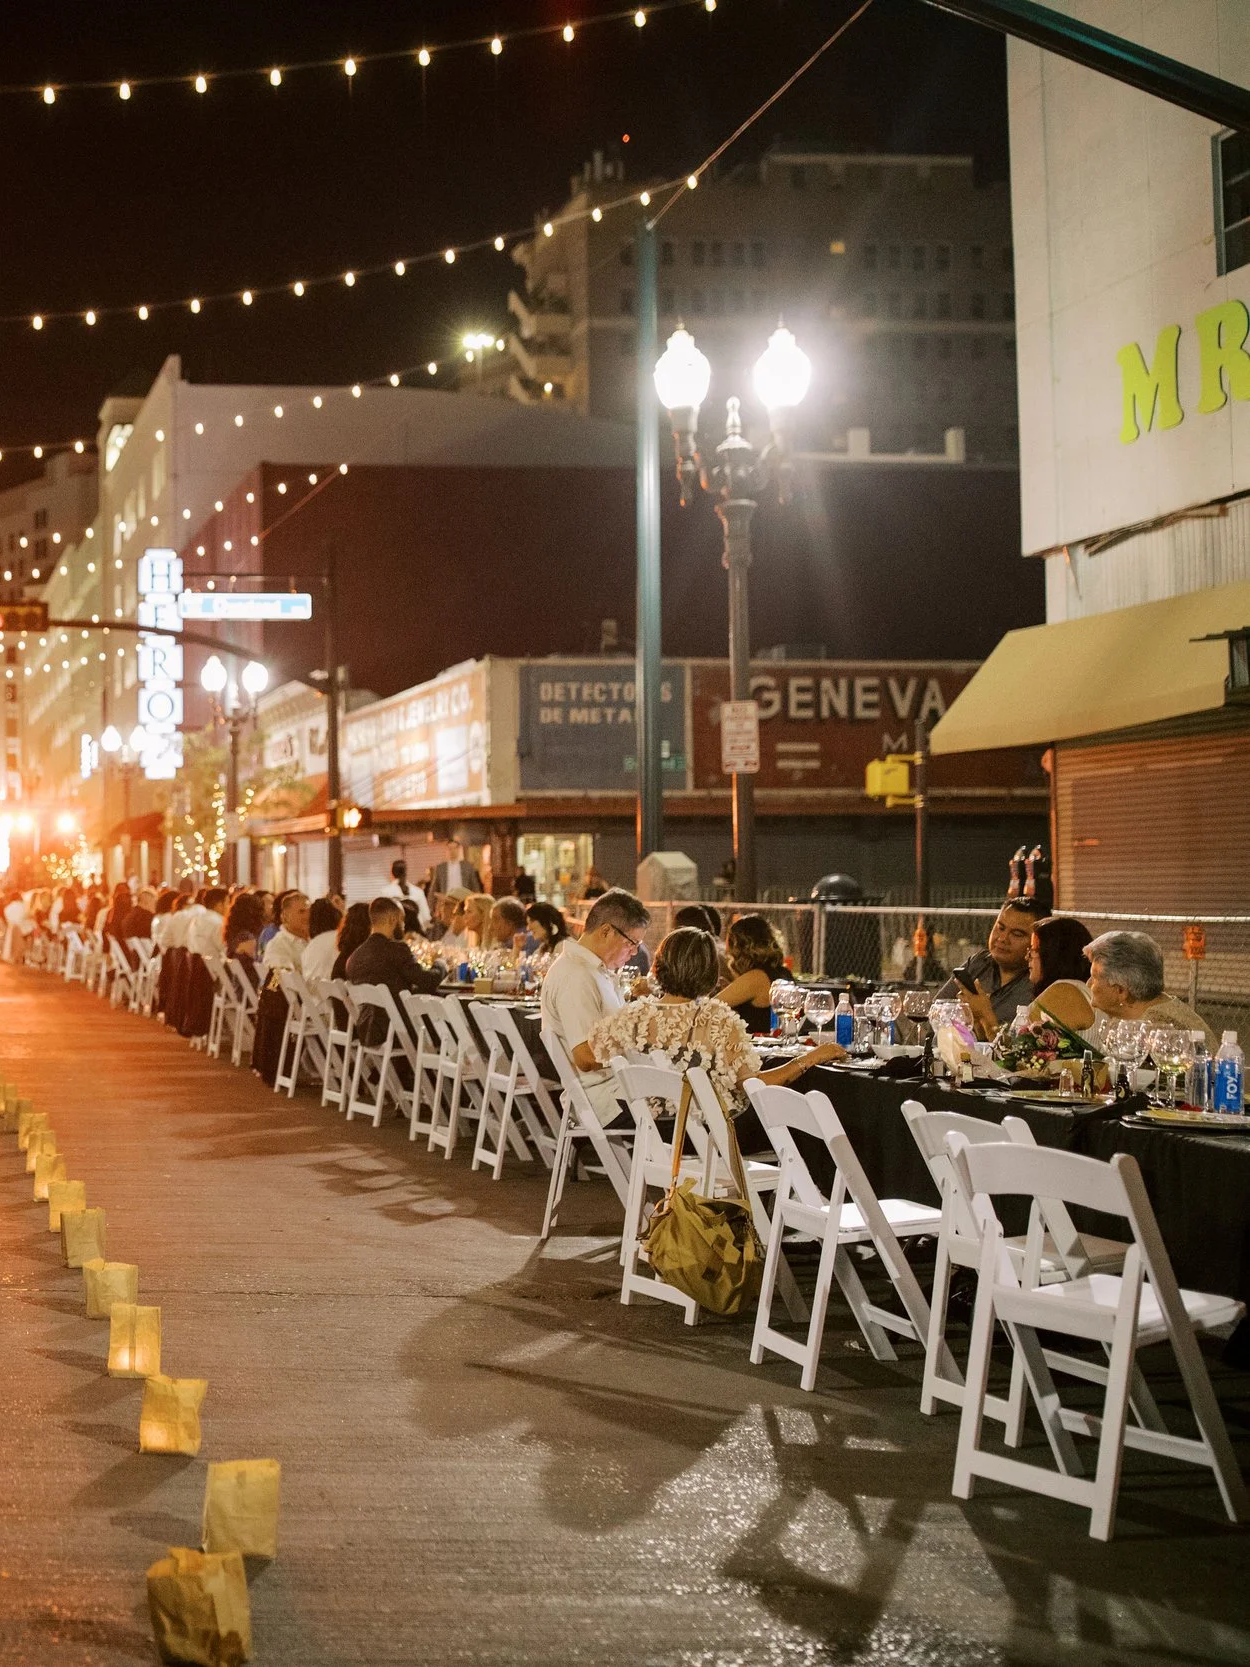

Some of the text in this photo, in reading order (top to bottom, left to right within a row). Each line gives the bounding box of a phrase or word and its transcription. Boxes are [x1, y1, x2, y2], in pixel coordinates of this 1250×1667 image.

[539, 681, 673, 703] DETECTOS
[750, 674, 947, 720] GENEVA
[539, 707, 634, 724] DE META
